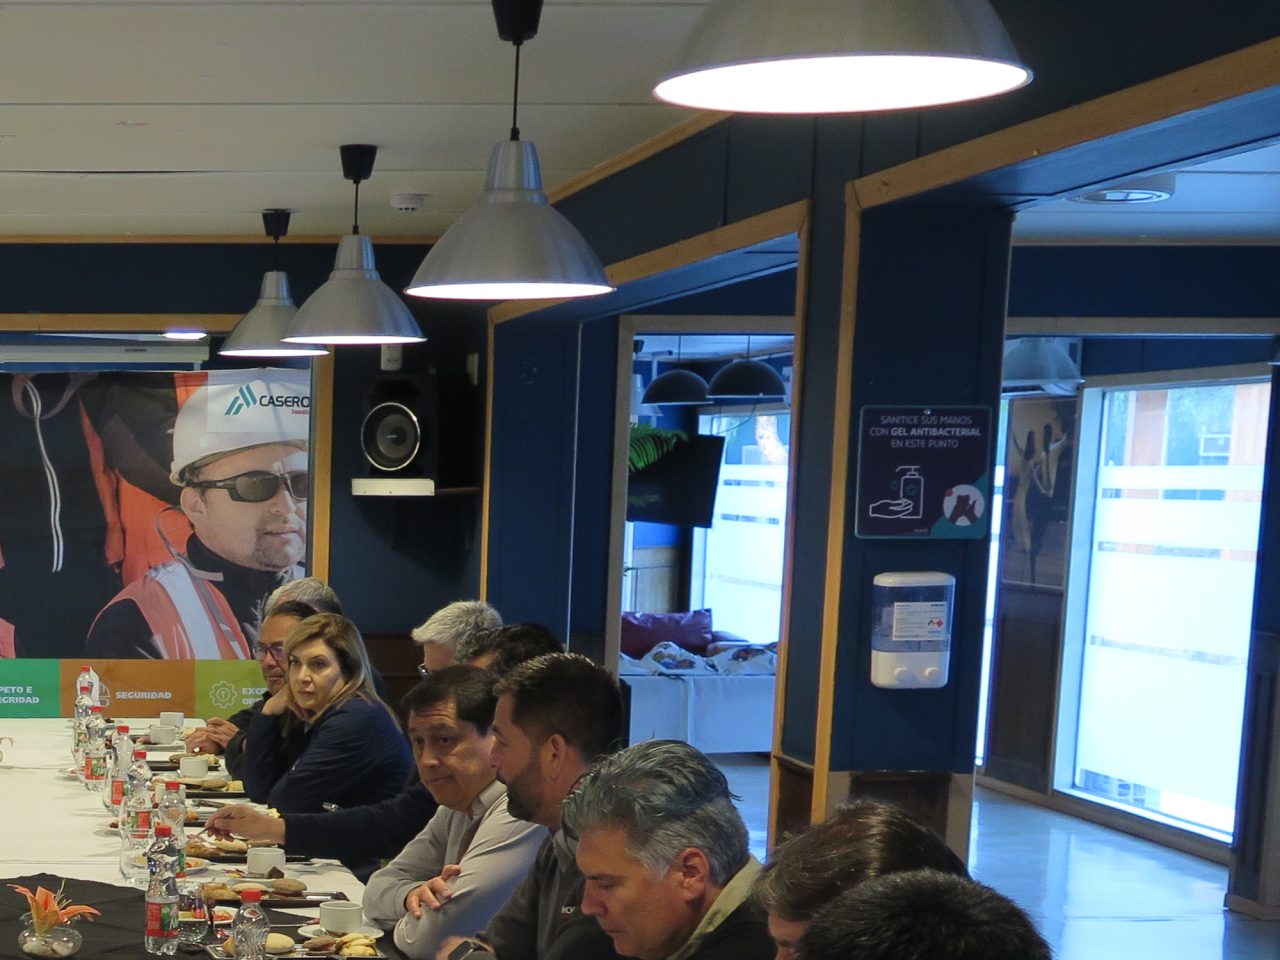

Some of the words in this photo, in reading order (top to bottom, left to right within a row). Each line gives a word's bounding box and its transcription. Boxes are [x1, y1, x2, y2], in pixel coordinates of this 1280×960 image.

[259, 395, 310, 408] CASERO
[880, 415, 919, 424] SANITICE
[921, 415, 938, 424] SUS
[940, 415, 972, 424] MANOS
[870, 427, 889, 436] CON
[891, 427, 908, 436] GEL
[910, 427, 981, 436] ANTIBACTERIAL
[891, 439, 903, 448] EN
[905, 439, 926, 448] ESTE
[928, 439, 959, 448] PUNTO
[26, 686, 33, 694] E
[115, 691, 172, 700] SEGURIDAD
